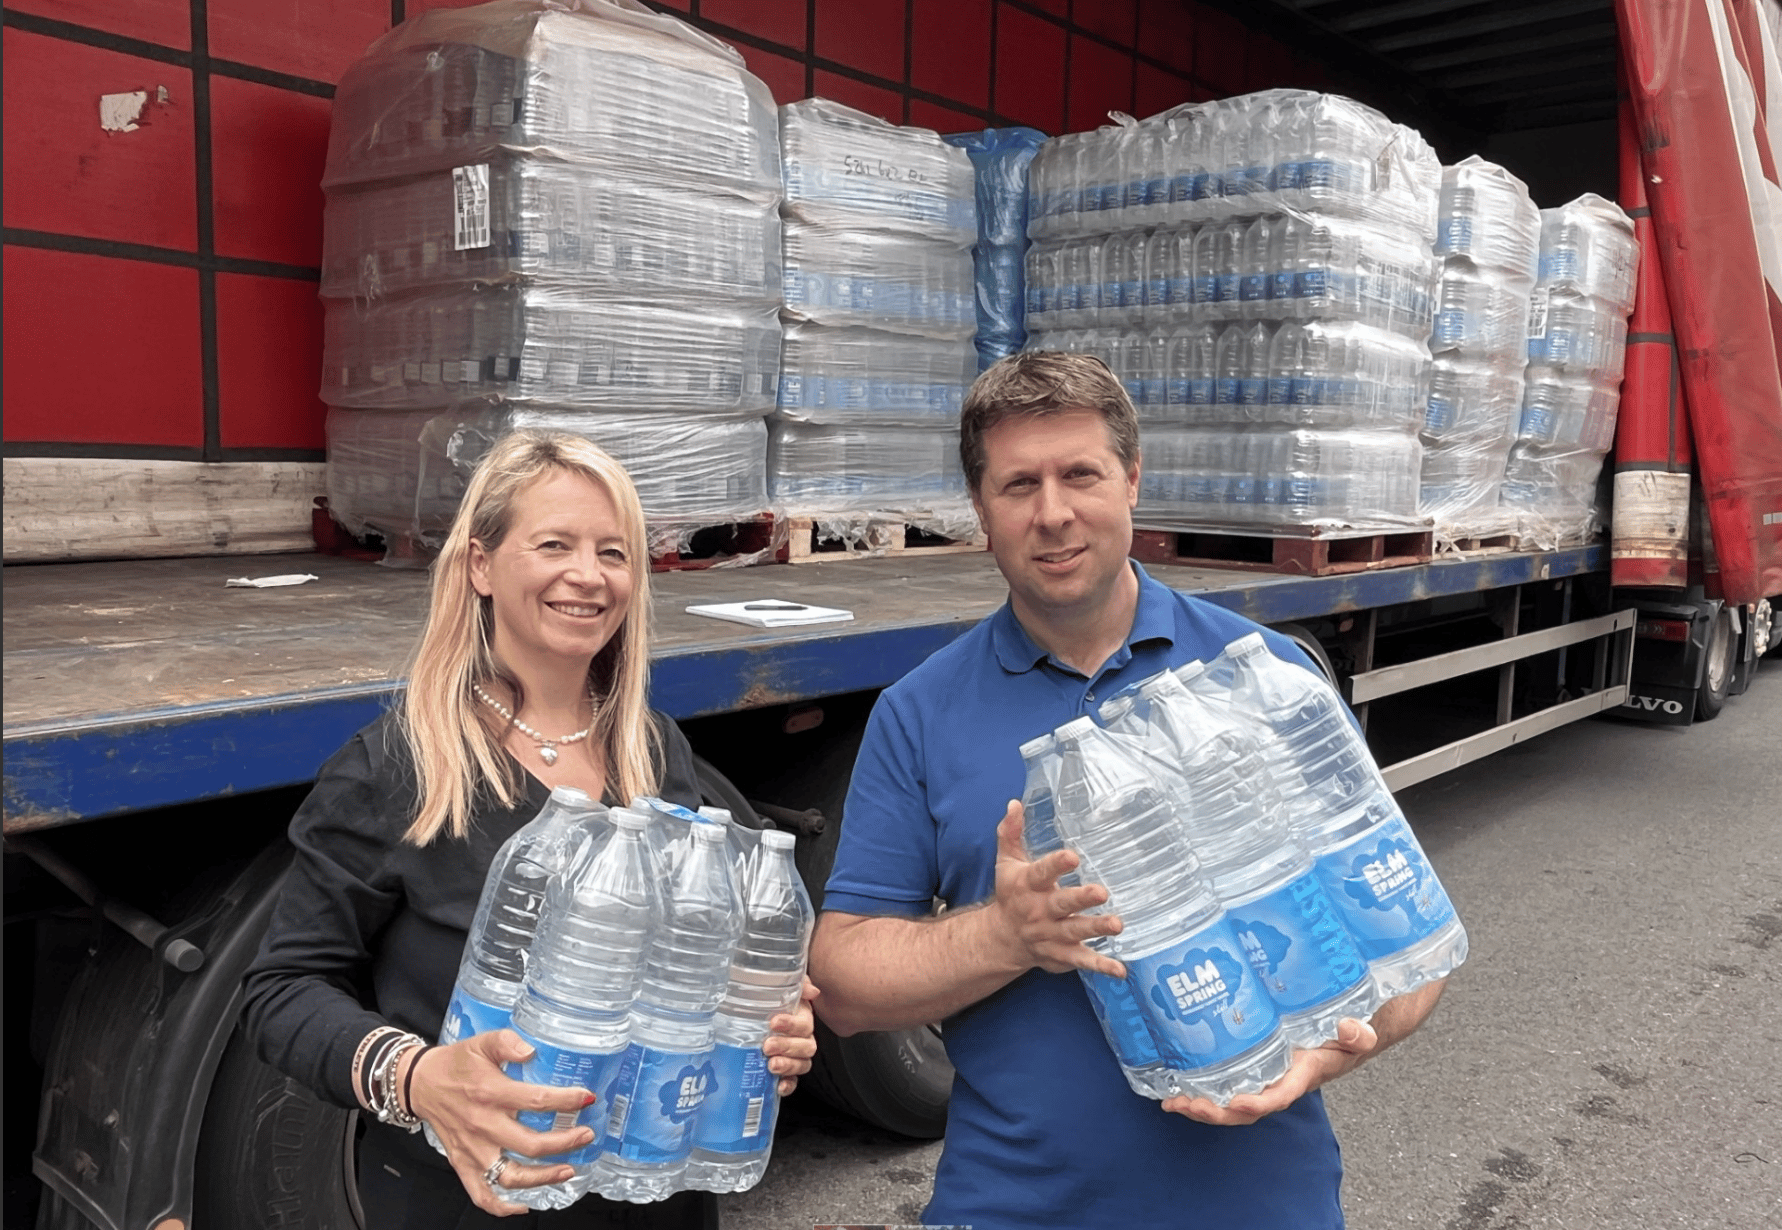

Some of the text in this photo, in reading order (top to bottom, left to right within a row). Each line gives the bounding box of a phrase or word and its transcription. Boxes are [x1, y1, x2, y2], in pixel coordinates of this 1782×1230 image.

[1622, 695, 1683, 714] LVO
[1363, 847, 1410, 885] ELM
[1373, 867, 1415, 898] SPRING
[1166, 958, 1220, 997] ELM
[1176, 979, 1227, 1010] SPRING
